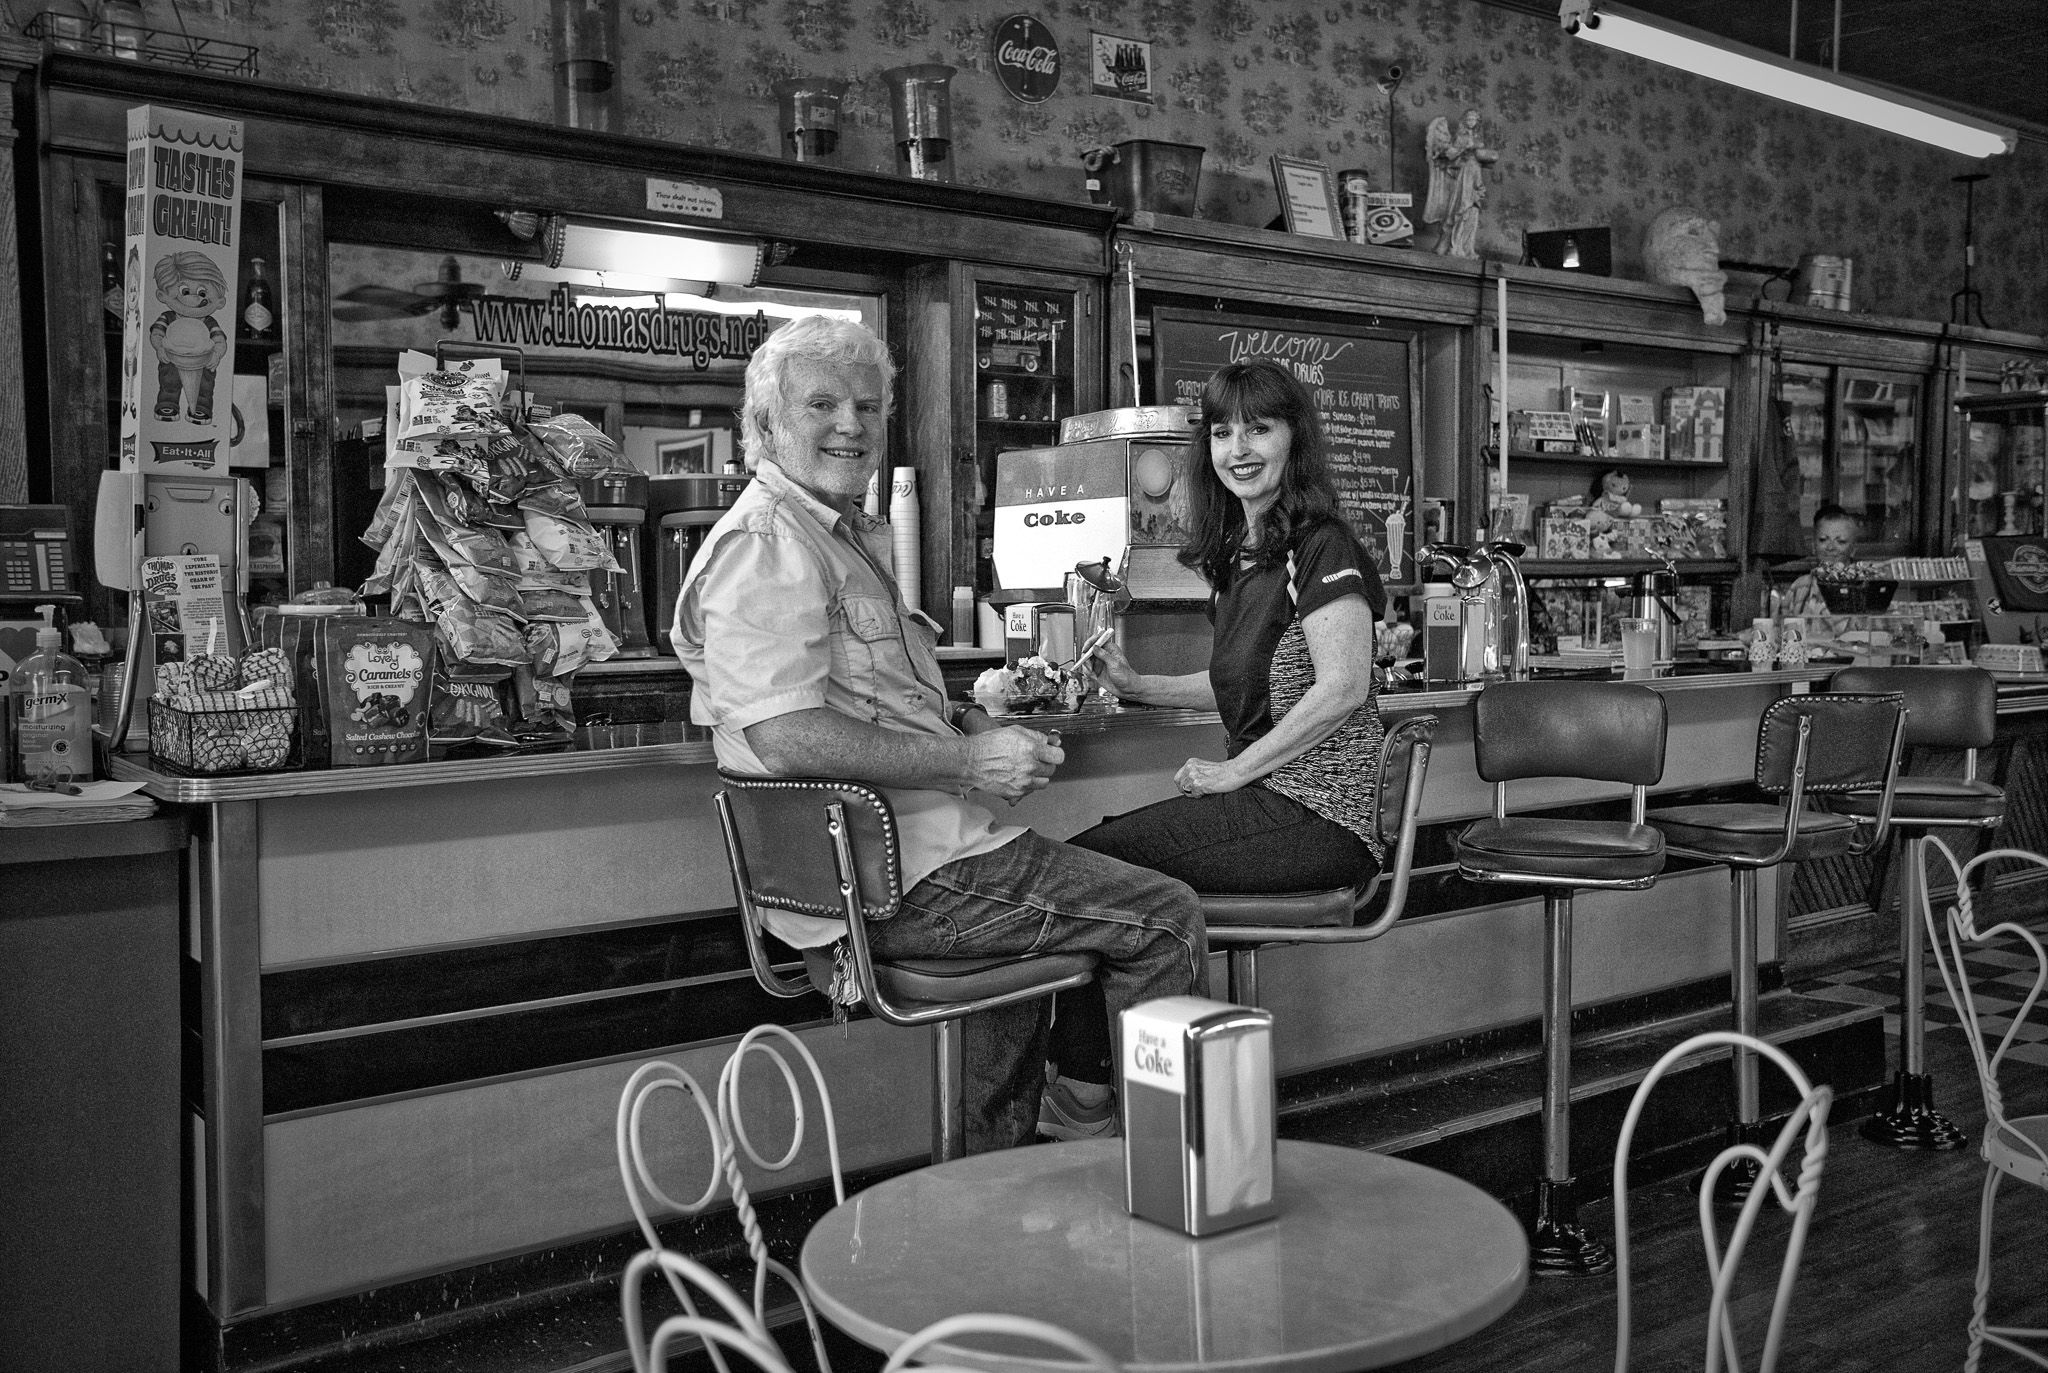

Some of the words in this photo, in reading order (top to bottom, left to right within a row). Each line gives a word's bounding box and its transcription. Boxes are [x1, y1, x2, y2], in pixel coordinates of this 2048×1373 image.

[998, 40, 1057, 75] Coca-Cola
[154, 145, 236, 200] TASTES
[153, 194, 233, 247] GREAT!
[470, 282, 769, 371] www.thomasdrugs.net
[1219, 331, 1354, 364] Welcome
[1294, 362, 1324, 386] DRUGS
[1313, 387, 1336, 410] MORE
[1351, 391, 1375, 410] CREAM
[1025, 486, 1067, 498] HAVE
[1077, 484, 1085, 495] A
[1024, 510, 1086, 527] Coke
[147, 561, 174, 573] THOMAS
[146, 573, 177, 590] DRUGS
[1433, 610, 1456, 621] Coke
[1010, 620, 1027, 632] Coke
[368, 650, 400, 670] Lovely
[359, 668, 411, 682] Caramels
[25, 693, 68, 709] germ-X
[345, 732, 368, 741] Salted
[368, 732, 396, 741] Cashew
[1139, 1028, 1159, 1045] Have
[1160, 1037, 1166, 1048] a
[1134, 1044, 1174, 1076] Coke
